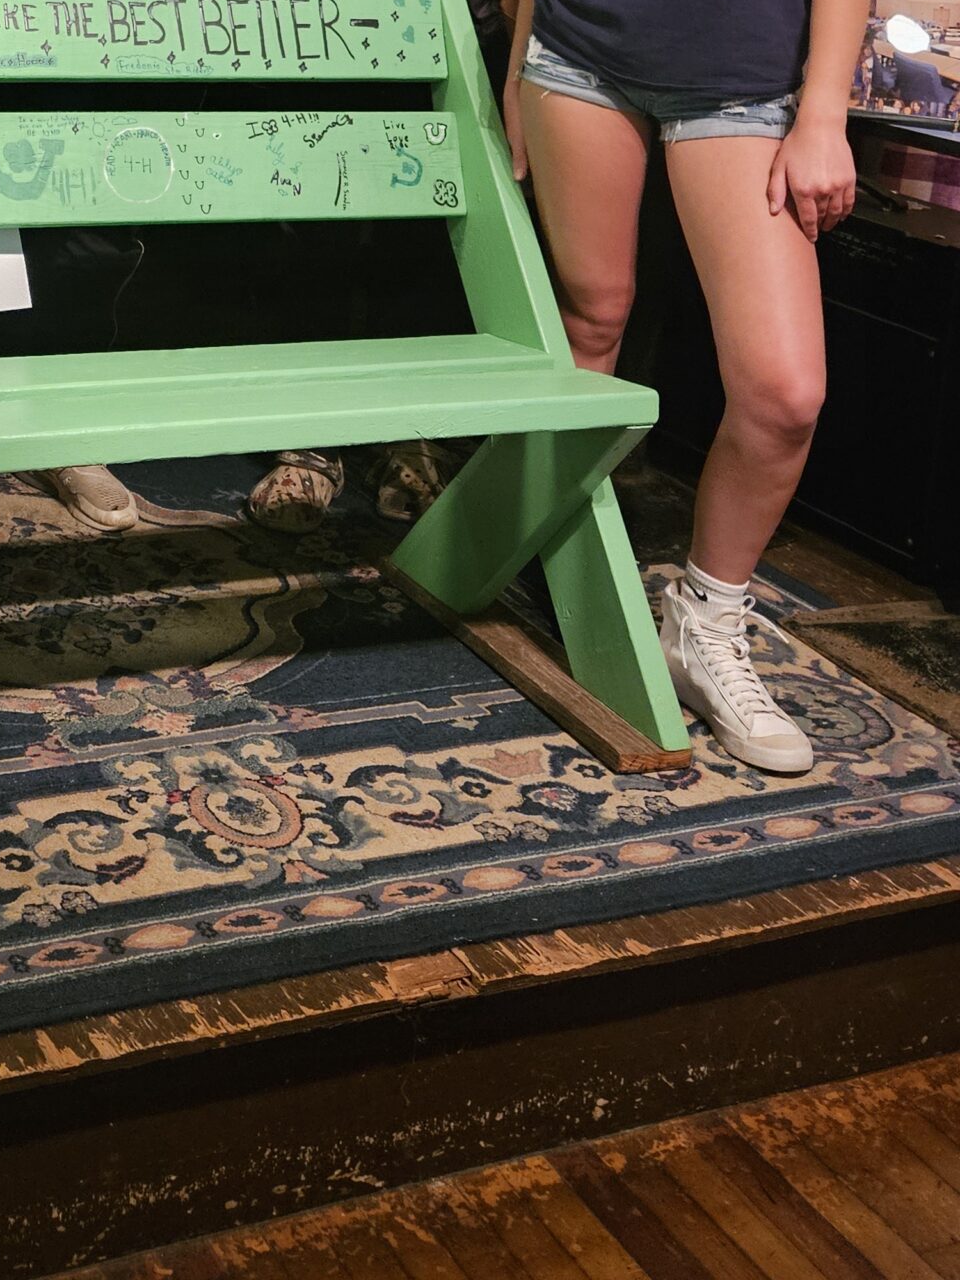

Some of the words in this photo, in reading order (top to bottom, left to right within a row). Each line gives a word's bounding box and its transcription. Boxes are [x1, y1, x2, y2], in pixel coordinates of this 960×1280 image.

[45, 1, 98, 38] THE
[383, 120, 406, 130] Live
[385, 132, 409, 143] Love
